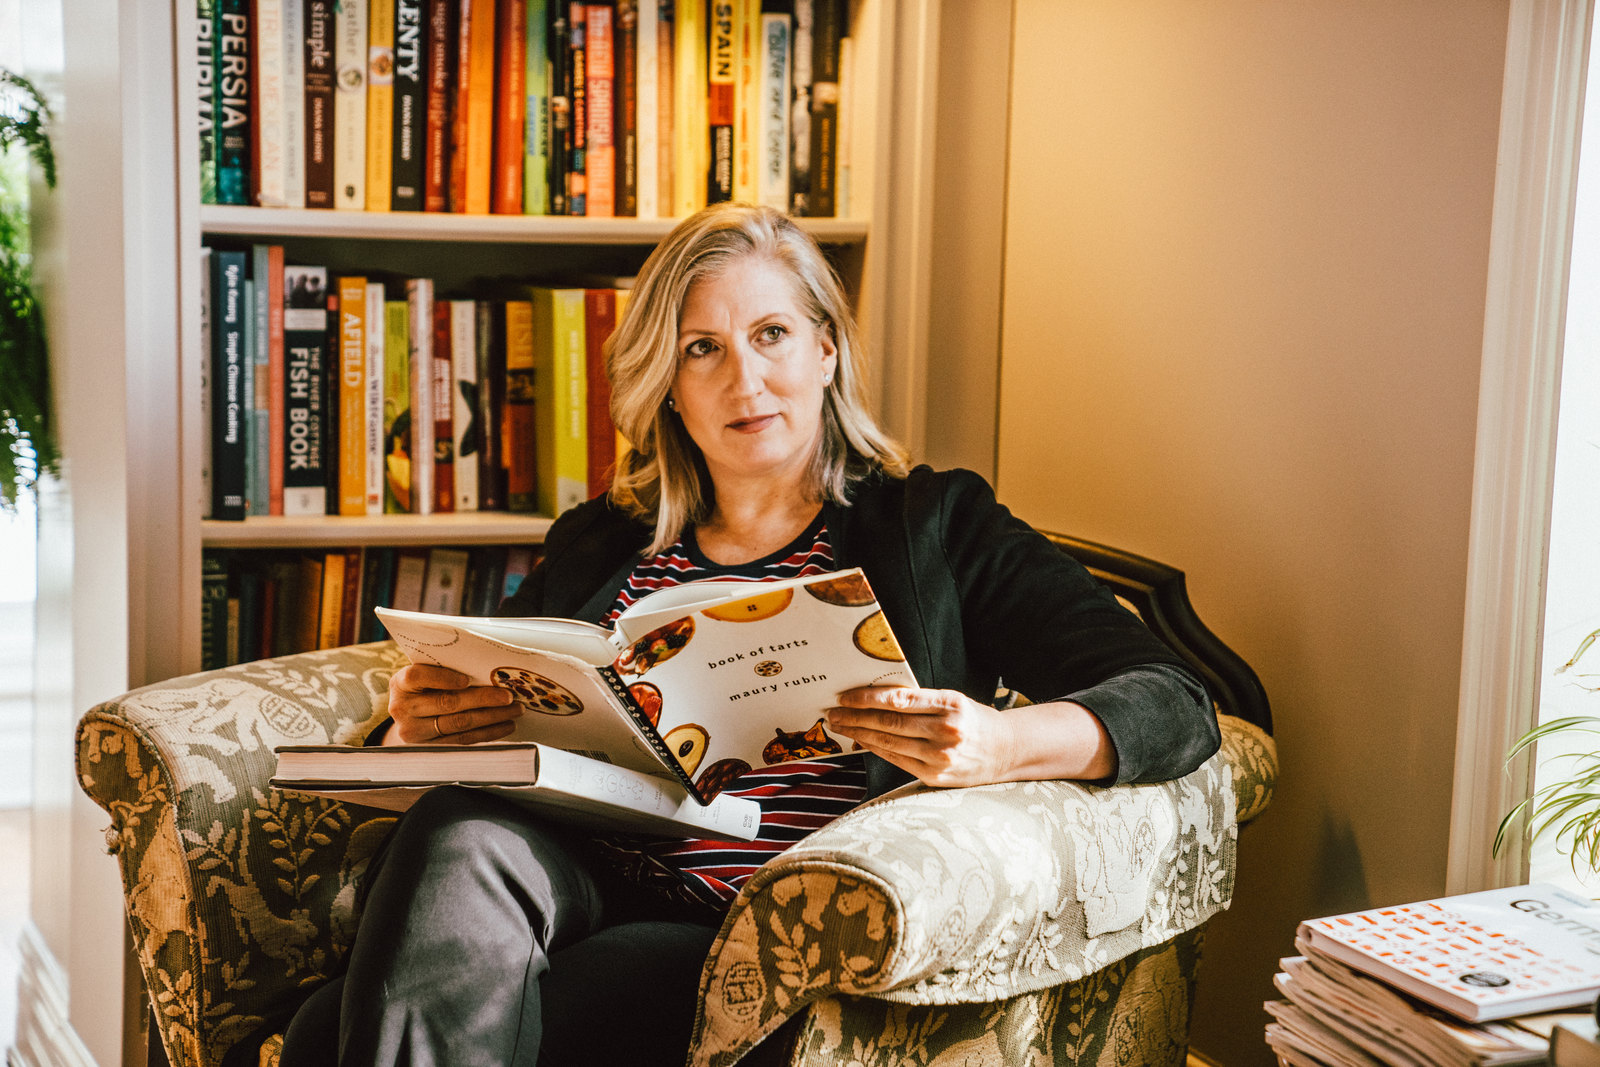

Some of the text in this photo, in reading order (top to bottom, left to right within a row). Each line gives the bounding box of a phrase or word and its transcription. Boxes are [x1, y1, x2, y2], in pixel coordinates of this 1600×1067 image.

[307, 2, 331, 68] simple
[344, 1, 360, 56] gather
[716, 3, 733, 77] SPAIN
[221, 13, 247, 129] PERSIA
[225, 264, 239, 288] Kylie
[227, 331, 239, 363] Simple
[290, 347, 308, 398] FISH
[343, 312, 362, 387] AFIELD
[227, 364, 239, 402] Chinese
[310, 346, 320, 469] THE RIVER COTTAGE
[225, 402, 239, 443] Cooking
[290, 407, 309, 470] BOOK
[708, 639, 809, 669] book of tarts
[729, 673, 828, 701] maury rubin
